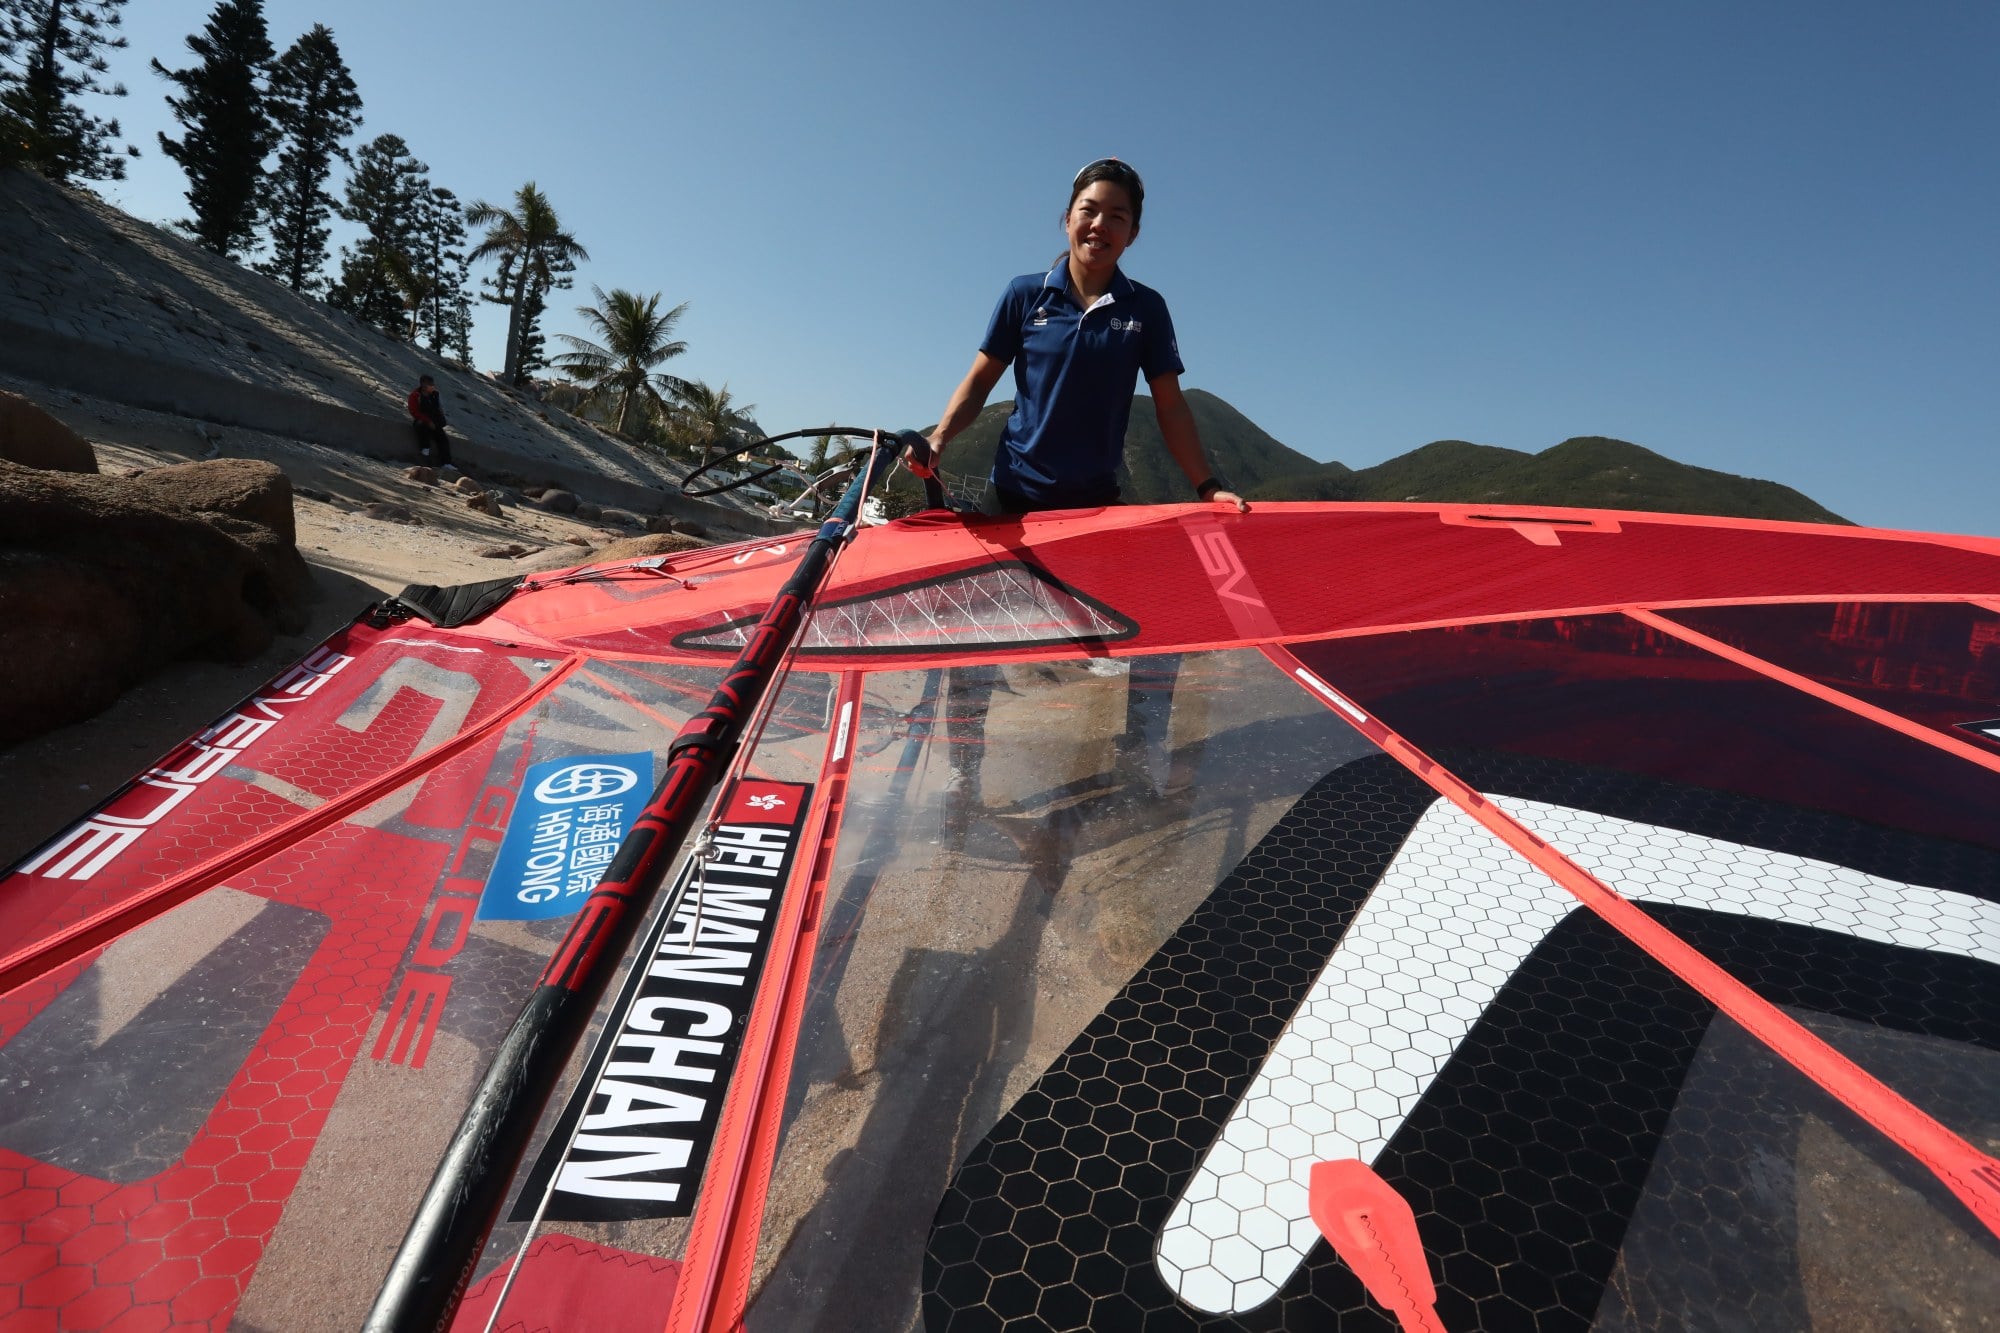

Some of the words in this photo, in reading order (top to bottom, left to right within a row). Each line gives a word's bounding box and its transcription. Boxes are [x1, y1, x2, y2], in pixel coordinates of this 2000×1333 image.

[16, 646, 355, 880] SEVERNE
[370, 785, 516, 1069] GLIDE
[517, 808, 574, 904] HAITONG
[705, 825, 790, 877] HEI
[648, 881, 772, 986] MAN
[554, 996, 733, 1202] CHAN
